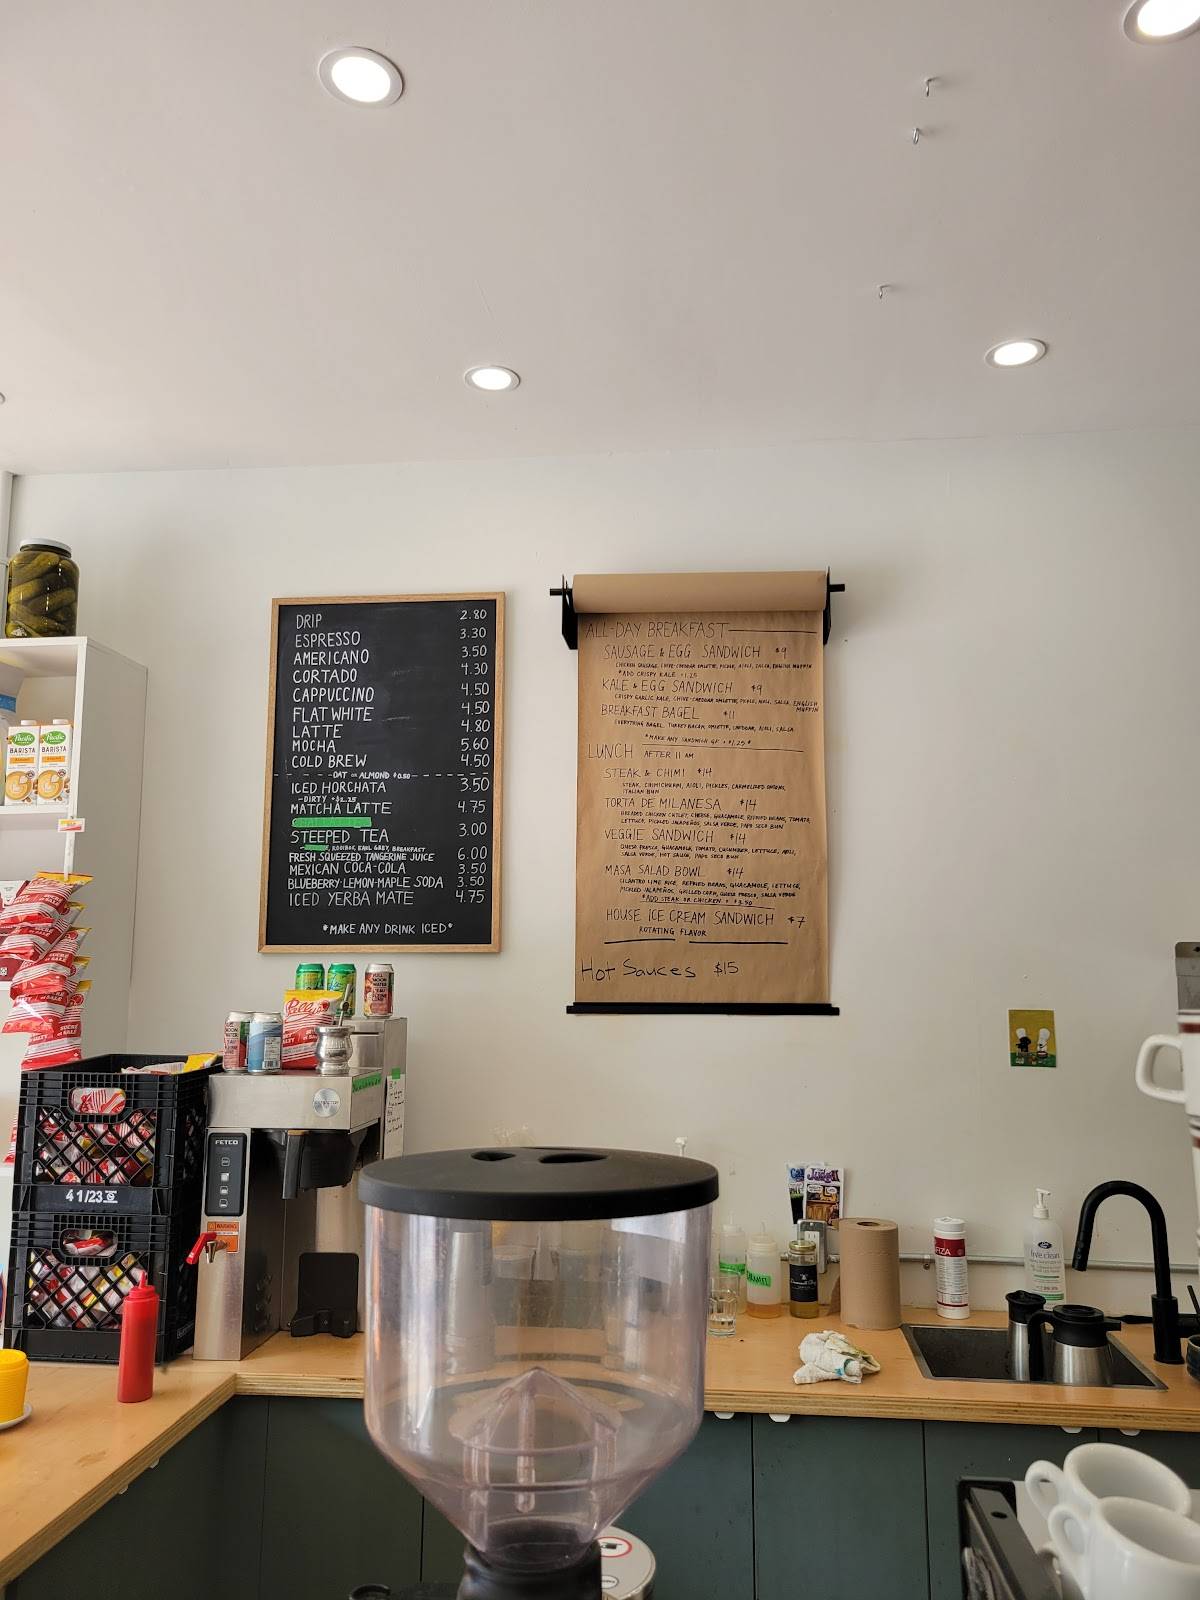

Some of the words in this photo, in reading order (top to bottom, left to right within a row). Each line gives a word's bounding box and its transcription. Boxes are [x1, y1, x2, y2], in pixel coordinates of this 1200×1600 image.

[296, 614, 322, 629] DRIP
[459, 609, 487, 620] 2.80
[295, 631, 361, 647] ESPRESSO
[459, 628, 487, 639] 3.30
[648, 621, 730, 638] BREAKFAST
[293, 649, 369, 665] AMERICANO
[461, 645, 487, 657] 3.50
[603, 644, 656, 660] SAUSAGE
[659, 648, 665, 657] &
[668, 644, 691, 659] EGG
[702, 644, 760, 659] SANDWICH
[292, 669, 357, 684] CORTADO
[461, 663, 488, 675] 4.30
[292, 687, 374, 702] CAPPUCCINO
[461, 682, 490, 696] 4.50
[602, 678, 629, 691] KALE
[641, 680, 665, 692] EGG
[671, 680, 732, 694] SANDWICH
[293, 707, 328, 723] FLAT
[331, 707, 374, 722] WHITE
[461, 701, 490, 715] 4.50
[601, 704, 660, 718] BREAKFAST
[662, 706, 701, 720] BAGEL
[292, 724, 344, 738] LATTE
[461, 719, 490, 733] 4.80
[292, 740, 336, 753] MOCHA
[461, 737, 489, 751] 5.60
[588, 743, 633, 759] LUNCH
[644, 750, 671, 759] AFTER
[291, 755, 323, 768] COLD
[328, 754, 368, 768] BREW
[461, 753, 490, 767] 4.50
[359, 771, 390, 779] ALMOND
[603, 768, 641, 779] STEAK
[644, 769, 651, 777] &
[656, 768, 685, 777] CHIMI
[291, 782, 317, 794] ICED
[321, 781, 387, 794] HORCHATA
[460, 777, 490, 793] 3.50
[290, 802, 342, 815] MATCHA
[346, 802, 392, 814] LATTE
[457, 800, 486, 813] 4.75
[605, 797, 635, 808] TORTA
[641, 797, 656, 808] DE
[660, 798, 721, 810] MILANESA
[291, 830, 350, 844] STEEPED
[360, 828, 389, 842] TEA
[458, 822, 487, 836] 3.00
[605, 829, 646, 841] VEGGIE
[652, 828, 714, 843] SANDWICH
[289, 852, 316, 862] FRESH
[319, 852, 361, 861] SQUEEZED
[365, 853, 407, 861] TANGERINE
[409, 853, 435, 861] JUICE
[457, 846, 487, 860] 6.00
[289, 863, 339, 876] MEXICAN
[344, 862, 406, 875] COCA-COLA
[458, 862, 487, 874] 3.50
[605, 865, 632, 876] MASA
[639, 864, 670, 877] SALAD
[674, 866, 706, 877] BOWL
[413, 876, 444, 888] SODA
[457, 876, 484, 887] 3.50
[289, 893, 320, 907] ICED
[327, 892, 371, 906] YERBA
[376, 891, 415, 905] MATE
[455, 890, 485, 903] 4.75
[606, 908, 642, 923] HOUSE
[648, 908, 664, 921] ICE
[669, 910, 706, 924] CREAM
[713, 910, 774, 926] SANDWICH
[359, 923, 380, 934] ANY
[385, 923, 415, 935] DRINK
[639, 926, 675, 935] ROTATING
[680, 928, 707, 937] FLAVOR
[581, 956, 616, 982] Hot
[622, 958, 696, 978] Sauces
[713, 961, 739, 977] $15
